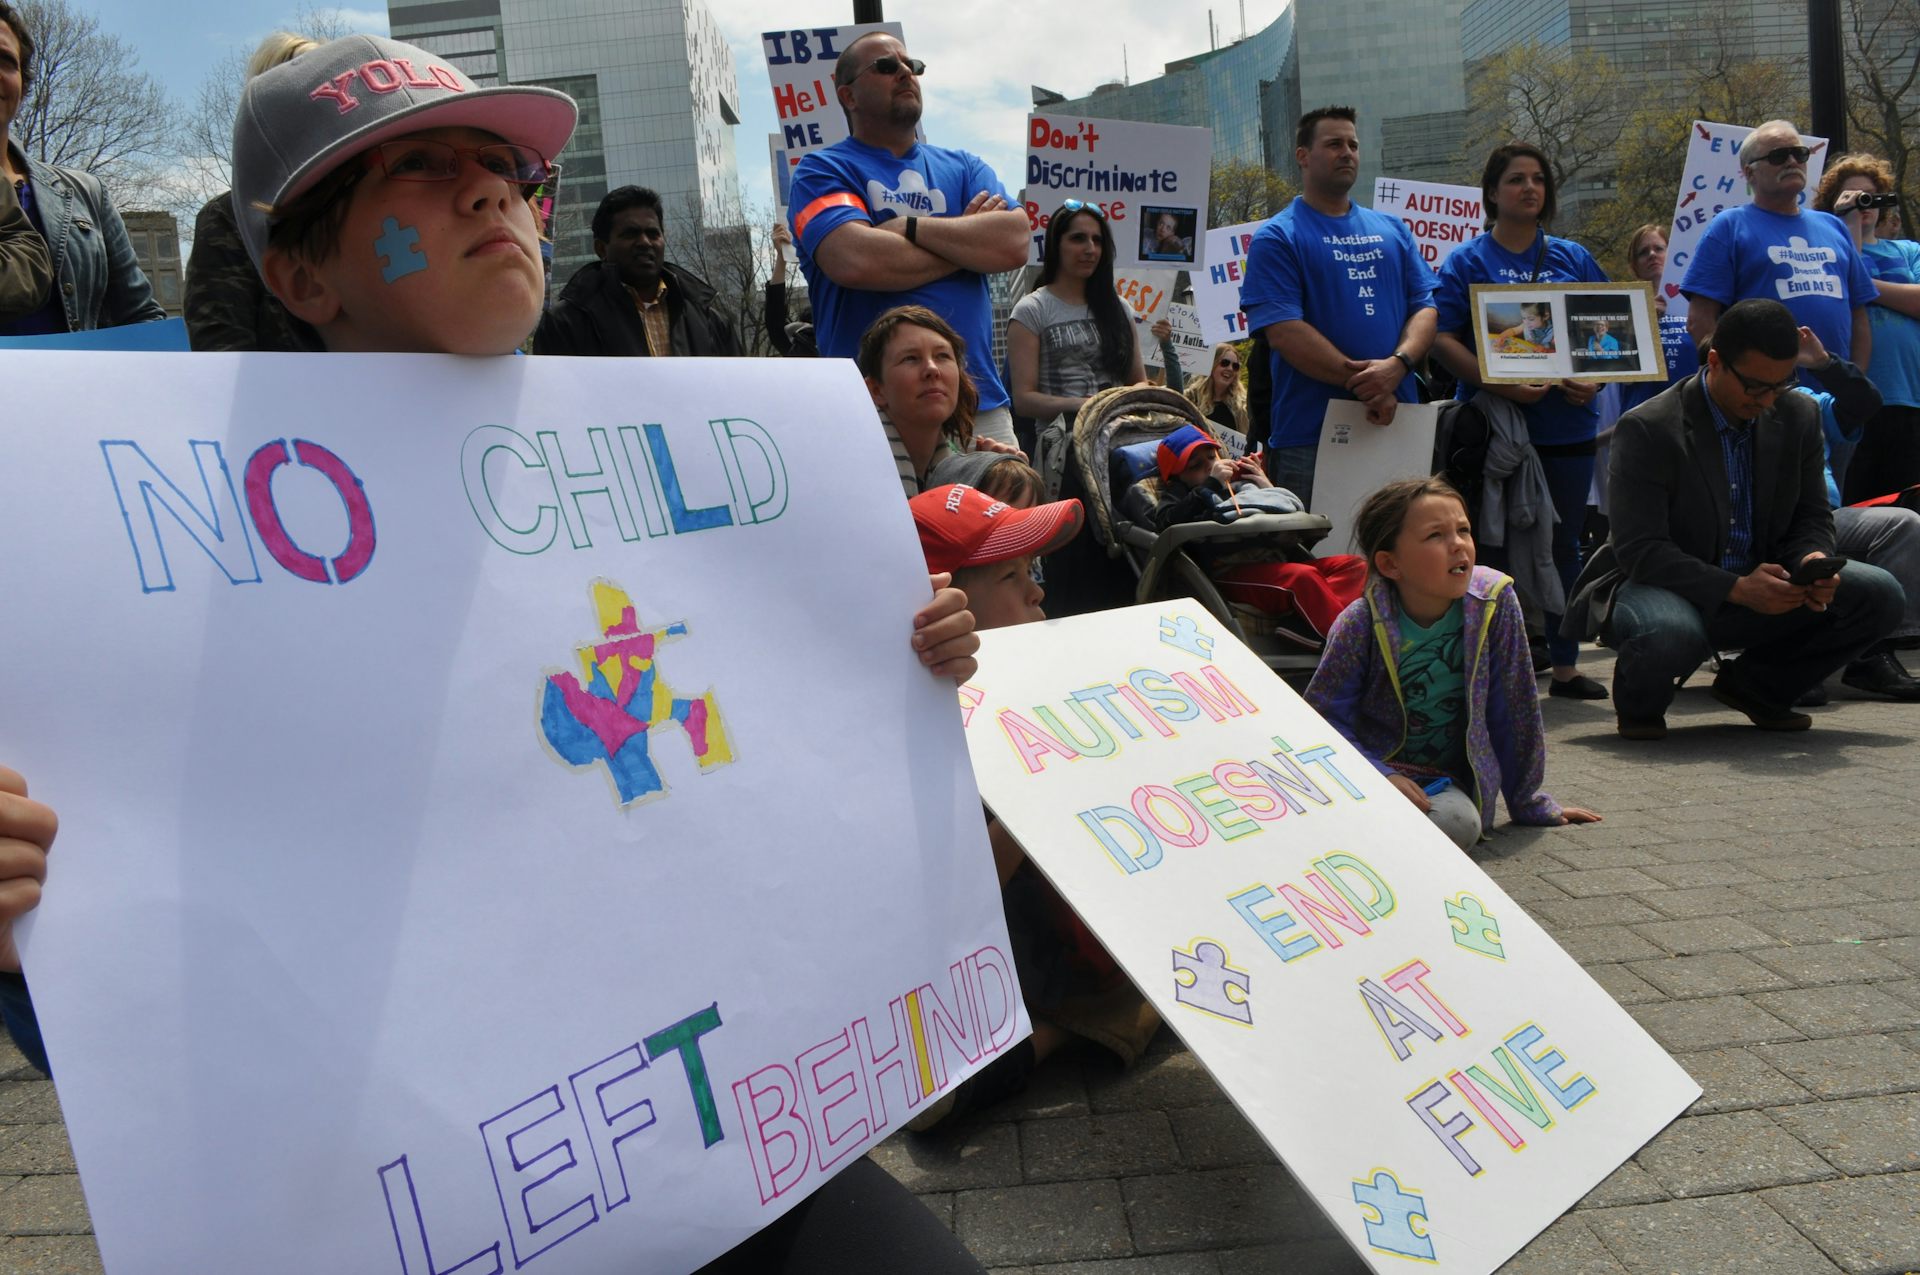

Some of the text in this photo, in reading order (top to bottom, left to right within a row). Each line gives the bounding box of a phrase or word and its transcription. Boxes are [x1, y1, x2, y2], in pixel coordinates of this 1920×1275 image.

[762, 29, 841, 65] IBI
[310, 57, 465, 115] YOLO
[773, 74, 836, 119] Hel
[784, 122, 823, 149] ME
[1029, 118, 1099, 152] Don't
[1405, 192, 1481, 219] AUTISM
[1322, 234, 1384, 245] #Autism
[1332, 248, 1384, 263] Doesn't
[1779, 250, 1828, 262] #Autism
[1347, 265, 1377, 280] End
[1787, 280, 1834, 293] End At 5
[1358, 286, 1375, 298] At
[1665, 348, 1679, 357] At
[98, 416, 790, 593] NO CHILD
[997, 663, 1259, 775] AUTISM
[1075, 735, 1366, 876] DOESN'T
[1226, 849, 1398, 964] END
[1357, 958, 1471, 1062] AT
[377, 945, 1018, 1275] LEFT BEHIND
[1405, 1022, 1597, 1178] FIVE
